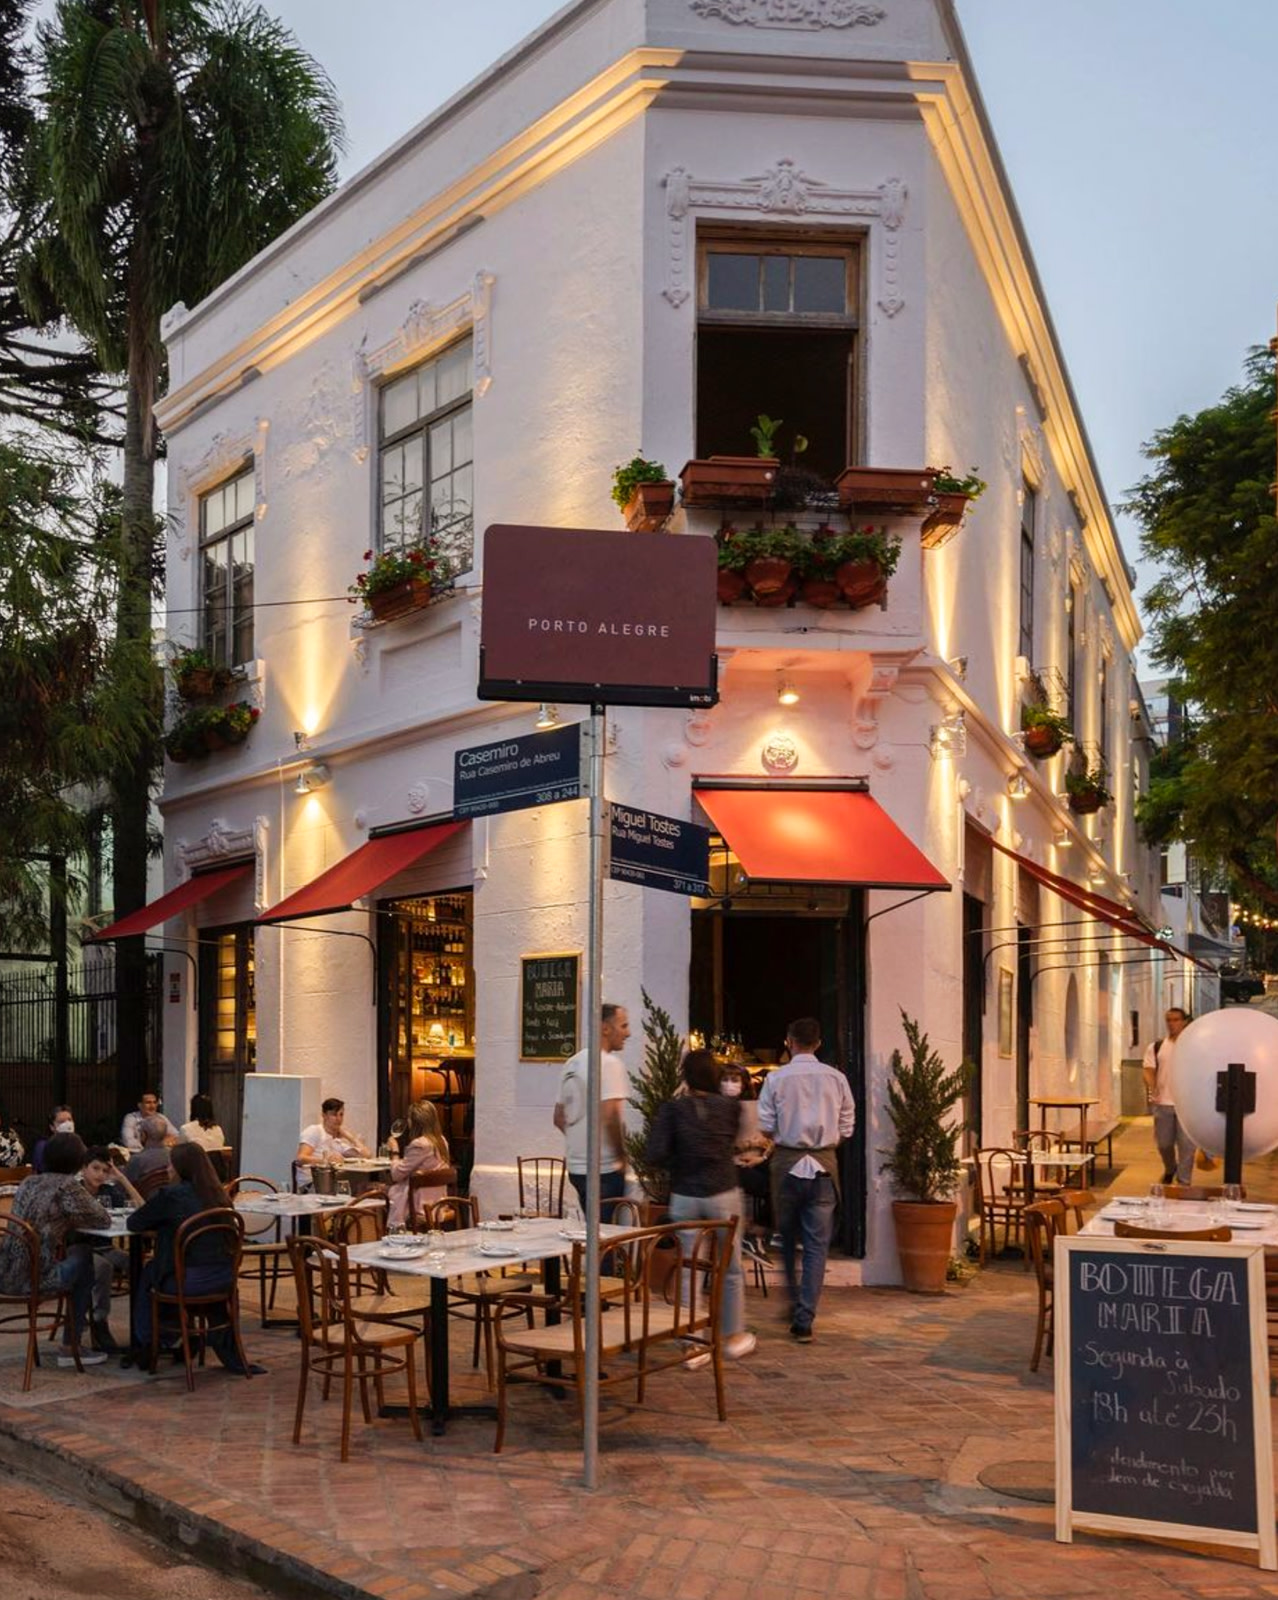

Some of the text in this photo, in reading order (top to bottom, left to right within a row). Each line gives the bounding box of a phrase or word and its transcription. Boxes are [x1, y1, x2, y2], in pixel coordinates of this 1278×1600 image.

[528, 618, 669, 638] PORTO ALEGRE
[459, 743, 519, 767] Casemiro
[460, 751, 561, 781] Rua Casemiro de Abreu
[536, 792, 553, 803] 308
[554, 791, 560, 800] a
[561, 786, 578, 798] 244
[612, 805, 682, 838] Miguel Tostes
[612, 825, 675, 850] Rua Miguel Tostes
[1080, 1262, 1240, 1306] BOTTEGA
[1098, 1302, 1215, 1338] MARIA
[1085, 1341, 1167, 1380] Segunda
[1139, 1397, 1181, 1428] até
[1142, 1472, 1160, 1488] de
[1208, 1469, 1235, 1489] por
